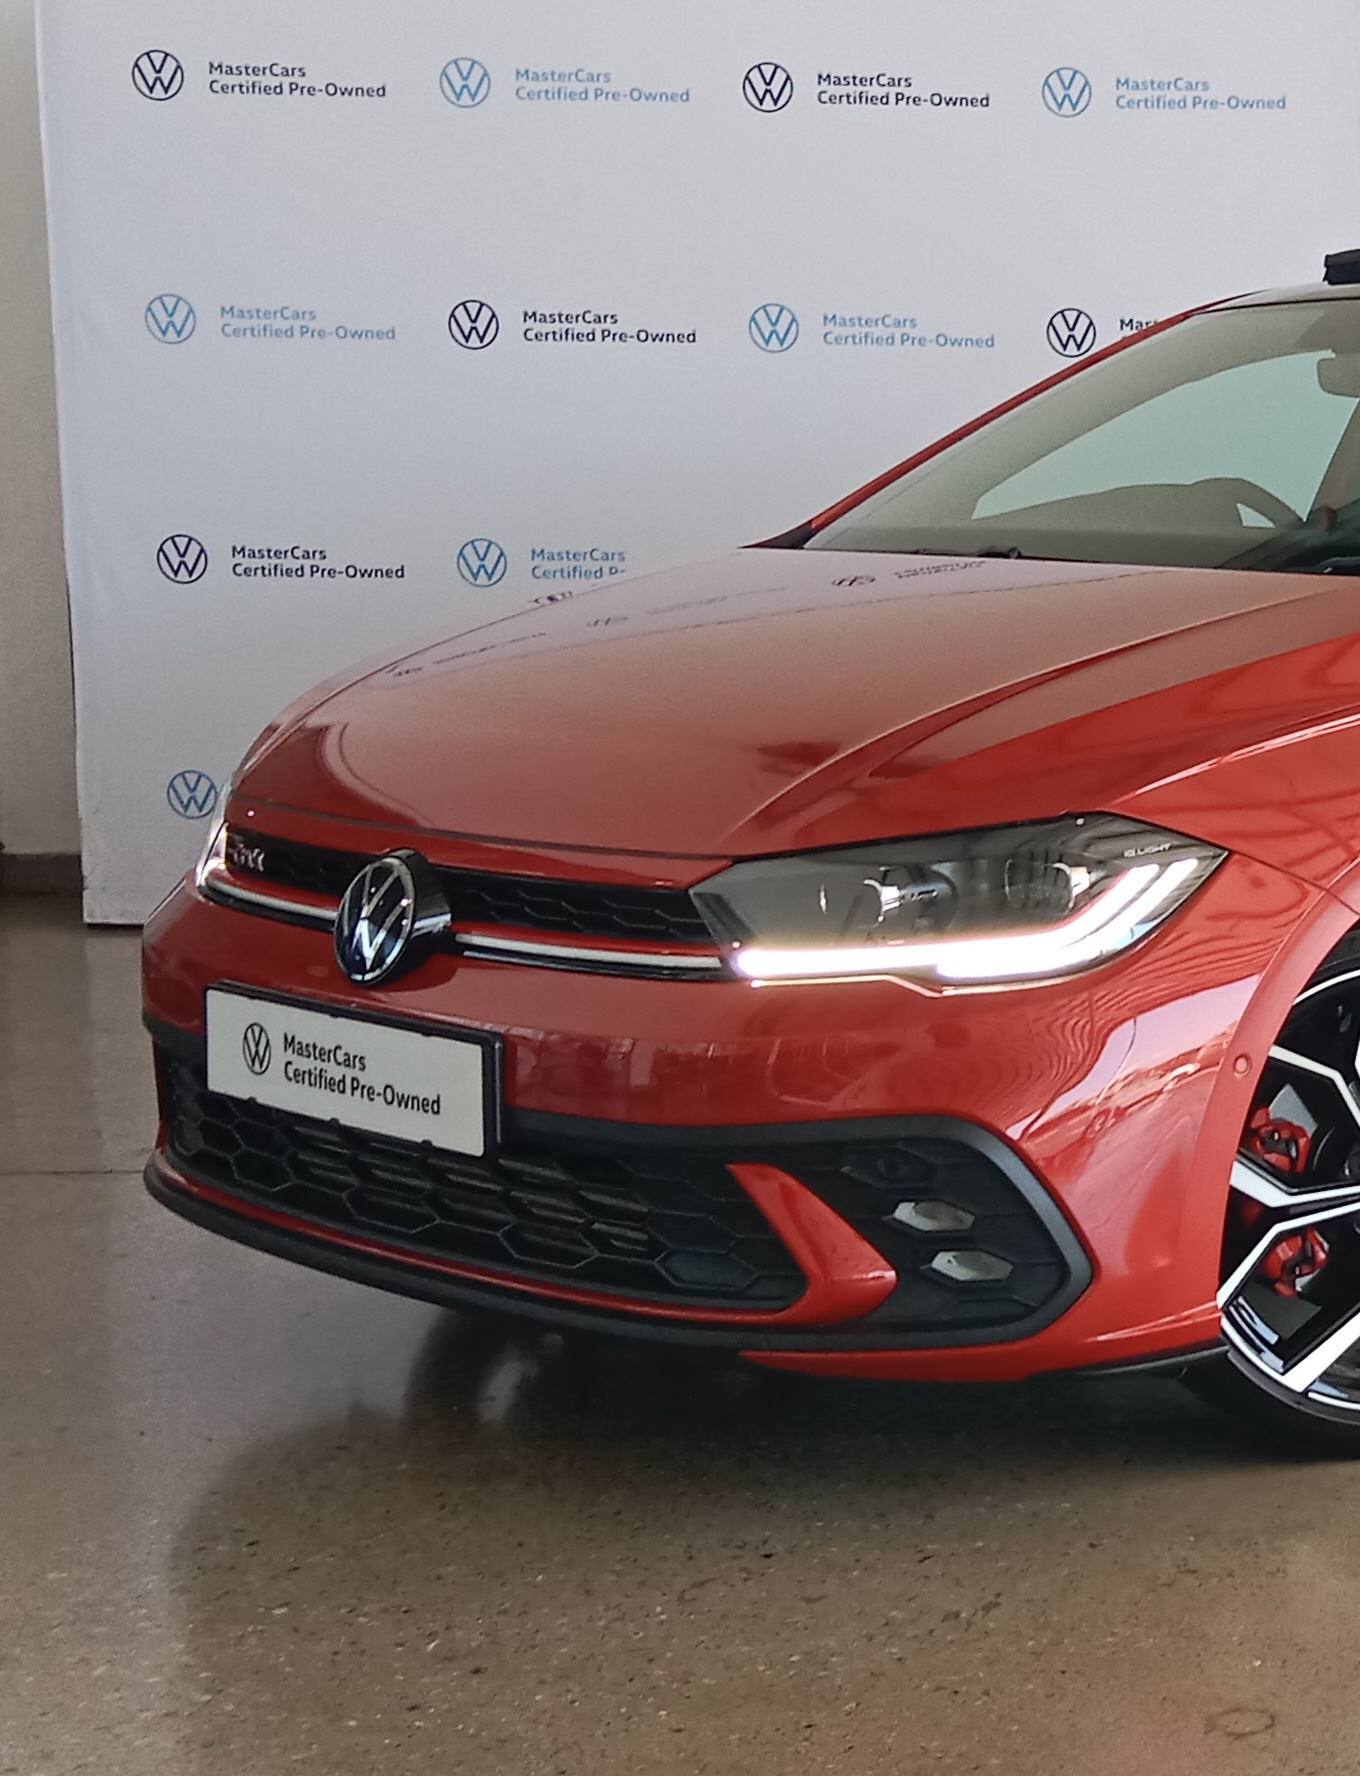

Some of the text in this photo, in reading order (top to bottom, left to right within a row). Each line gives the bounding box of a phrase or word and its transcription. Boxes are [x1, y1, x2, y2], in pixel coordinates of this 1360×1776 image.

[209, 61, 306, 77] MasterCars
[515, 68, 611, 83] MasterCars
[209, 79, 386, 98] Certified Pre-Owned
[817, 73, 912, 88] MasterCars
[1116, 77, 1209, 91] MasterCars
[515, 86, 690, 103] Certified Pre-Owned
[817, 90, 989, 108] Certified Pre-Owned
[1116, 94, 1286, 110] Certified Pre-Owned
[220, 305, 316, 321] MasterCars
[523, 310, 618, 325] MasterCars
[823, 313, 918, 329] MasterCars
[221, 323, 395, 341] Certified Pre-Owned
[523, 327, 696, 344] Certified Pre-Owned
[823, 331, 995, 348] Certified Pre-Owned
[232, 545, 327, 561] MasterCars
[531, 548, 625, 562] MasterCars
[232, 563, 405, 580] Certified Pre-Owned
[531, 565, 604, 580] Certified
[283, 1032, 366, 1072] MasterCars
[284, 1061, 441, 1115] Certified Pre-Owned
